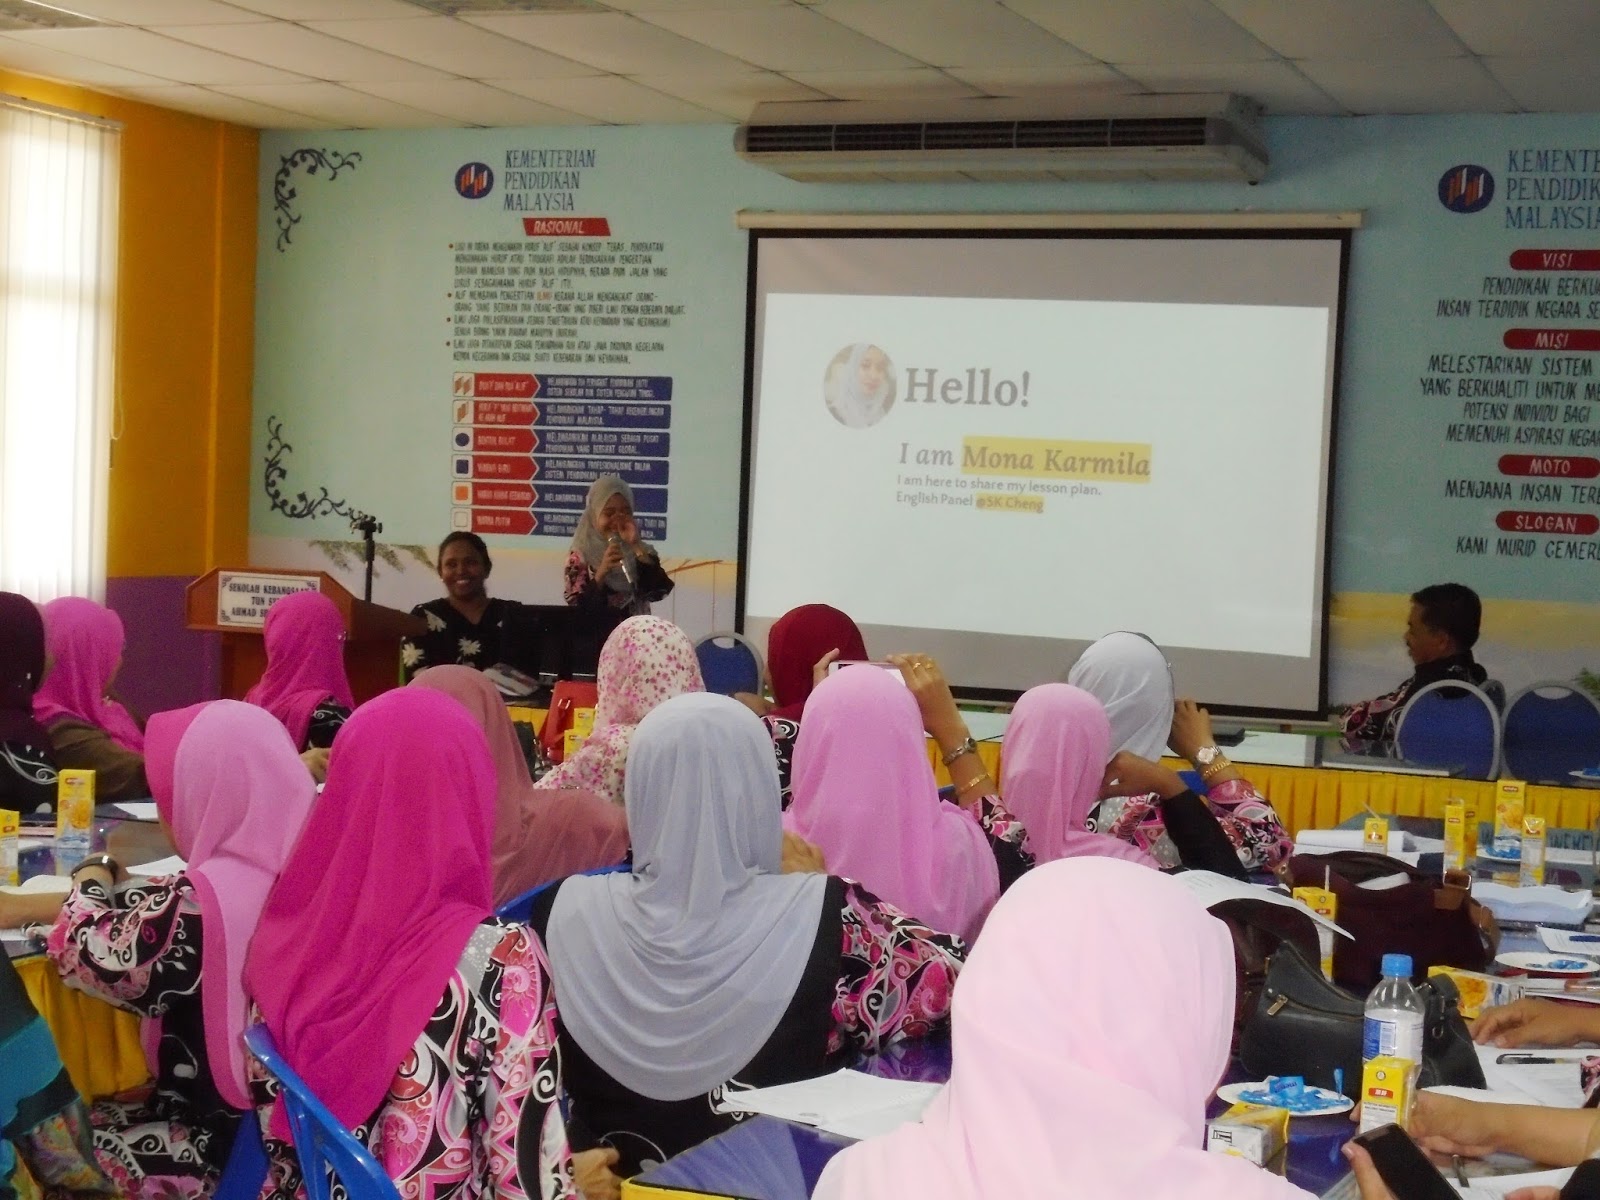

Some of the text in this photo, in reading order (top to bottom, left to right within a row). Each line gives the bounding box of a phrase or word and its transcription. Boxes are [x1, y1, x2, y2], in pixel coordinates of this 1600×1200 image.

[505, 150, 596, 168] KEMENTERIAN
[504, 171, 580, 190] PENDIDIKAN
[503, 193, 575, 211] MALAYSIA
[533, 220, 585, 234] RASIONAL
[1543, 253, 1573, 268] VISI
[1482, 276, 1549, 295] PENDIDIKAN
[1436, 299, 1470, 317] INSAN
[1478, 300, 1529, 318] TERDIDIK
[1535, 301, 1581, 319] NEGARA
[1535, 332, 1569, 349] MISI
[1427, 354, 1592, 377] MELESTARIKAN SISTEM
[904, 366, 1031, 408] Hello!
[1420, 377, 1451, 396] YANG
[1457, 378, 1529, 399] BERKUALITI
[1535, 381, 1577, 400] UNTUK
[1464, 402, 1592, 423] POTENSI INDIVIDU BAGI
[1446, 424, 1511, 443] MEMENUHI
[1514, 426, 1565, 446] ASPIRASI
[899, 442, 1151, 476] I am Mona Karmila
[1529, 458, 1571, 475] MOTO
[904, 476, 923, 486] am
[926, 475, 952, 488] here
[955, 478, 968, 489] to
[971, 477, 1004, 491] share
[1007, 482, 1026, 495] my
[1029, 480, 1067, 494] lesson
[1071, 483, 1101, 498] plan.
[1445, 479, 1513, 500] MENJANA
[1520, 483, 1562, 503] INSAN
[896, 491, 939, 508] English
[941, 493, 973, 506] Panel
[1006, 497, 1044, 514] Cheng
[1515, 514, 1578, 533] SLOGAN
[1456, 536, 1488, 555] KAMI
[1496, 538, 1537, 557] MURID
[229, 583, 310, 595] SEKOLAH KEBANGSA
[251, 596, 265, 606] TUN
[231, 607, 256, 617] AHMAD
